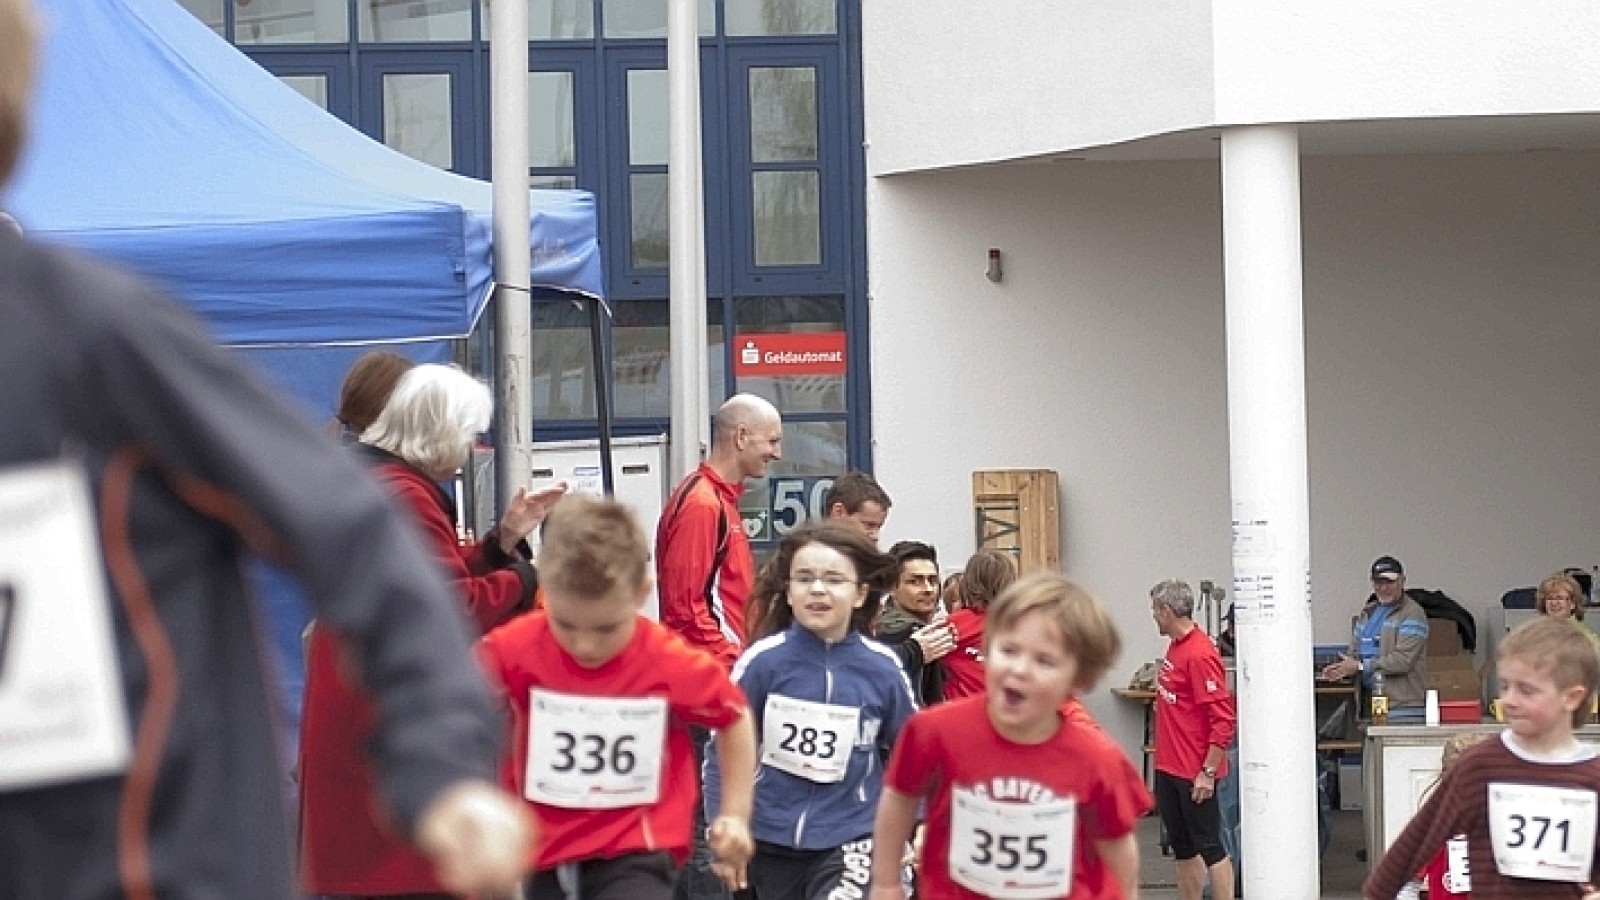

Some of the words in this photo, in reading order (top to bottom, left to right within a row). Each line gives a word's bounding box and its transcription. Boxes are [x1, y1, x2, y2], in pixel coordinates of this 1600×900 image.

[764, 350, 843, 364] Geldautomat
[551, 730, 636, 775] 336
[778, 723, 838, 759] 283
[970, 827, 1048, 872] 355
[1506, 813, 1570, 853] 371
